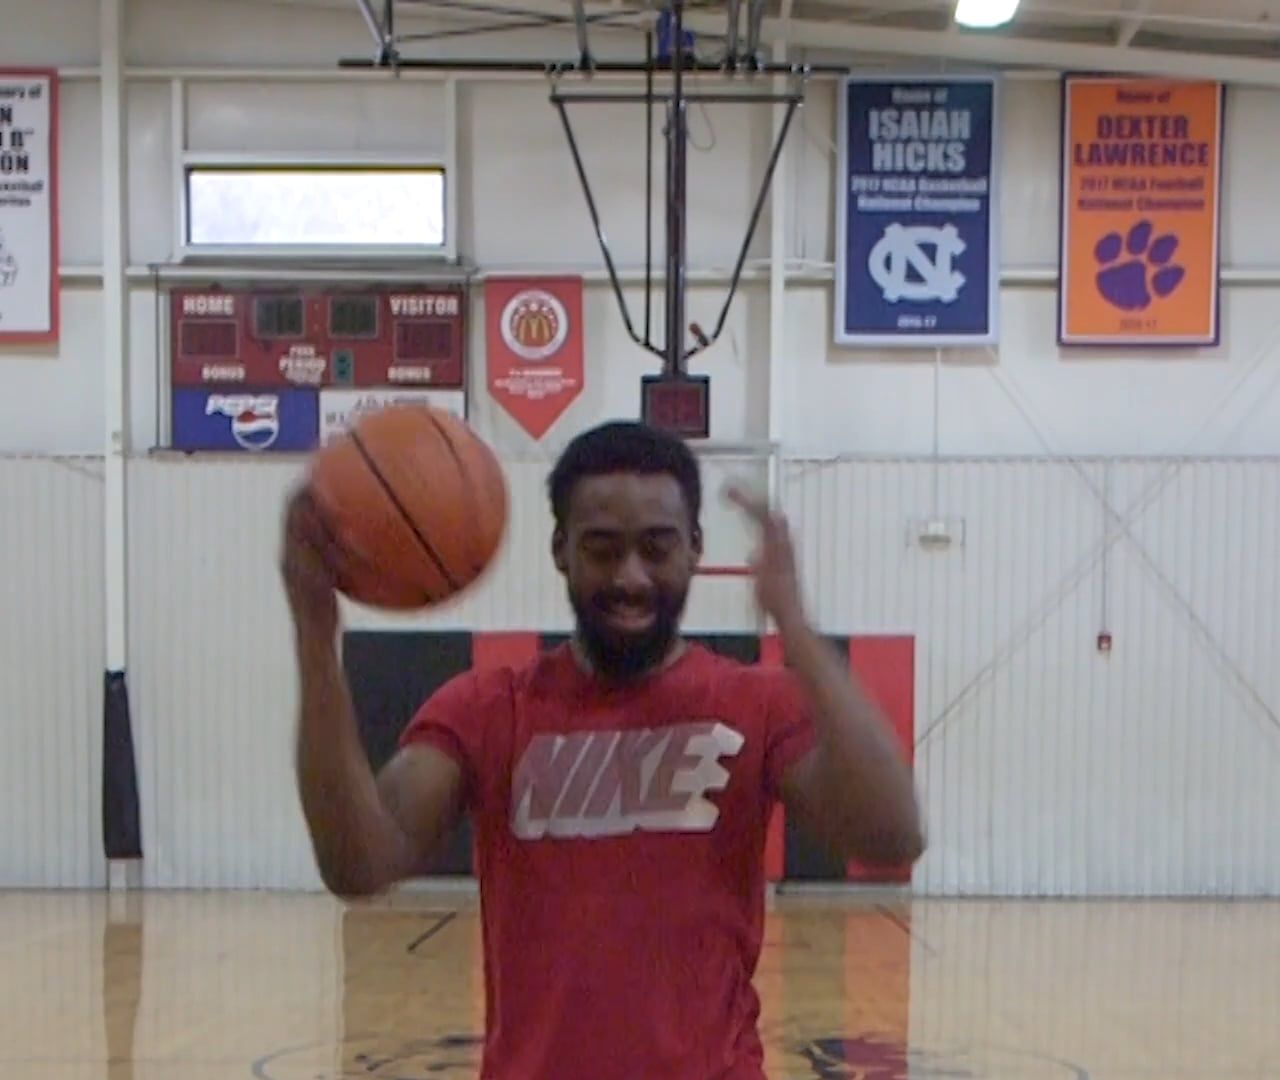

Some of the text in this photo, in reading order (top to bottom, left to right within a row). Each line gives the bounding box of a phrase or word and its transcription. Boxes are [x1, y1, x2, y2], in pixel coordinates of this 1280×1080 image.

[868, 109, 971, 140] ISAIAH
[1097, 115, 1188, 139] DEXTER
[872, 142, 967, 172] HICKS
[1074, 143, 1208, 167] LAWRENCE
[183, 295, 234, 315] HOME
[389, 295, 459, 316] VISITOR
[202, 364, 246, 381] BONUS
[387, 366, 431, 382] BONUS
[511, 722, 745, 840] NIKE
